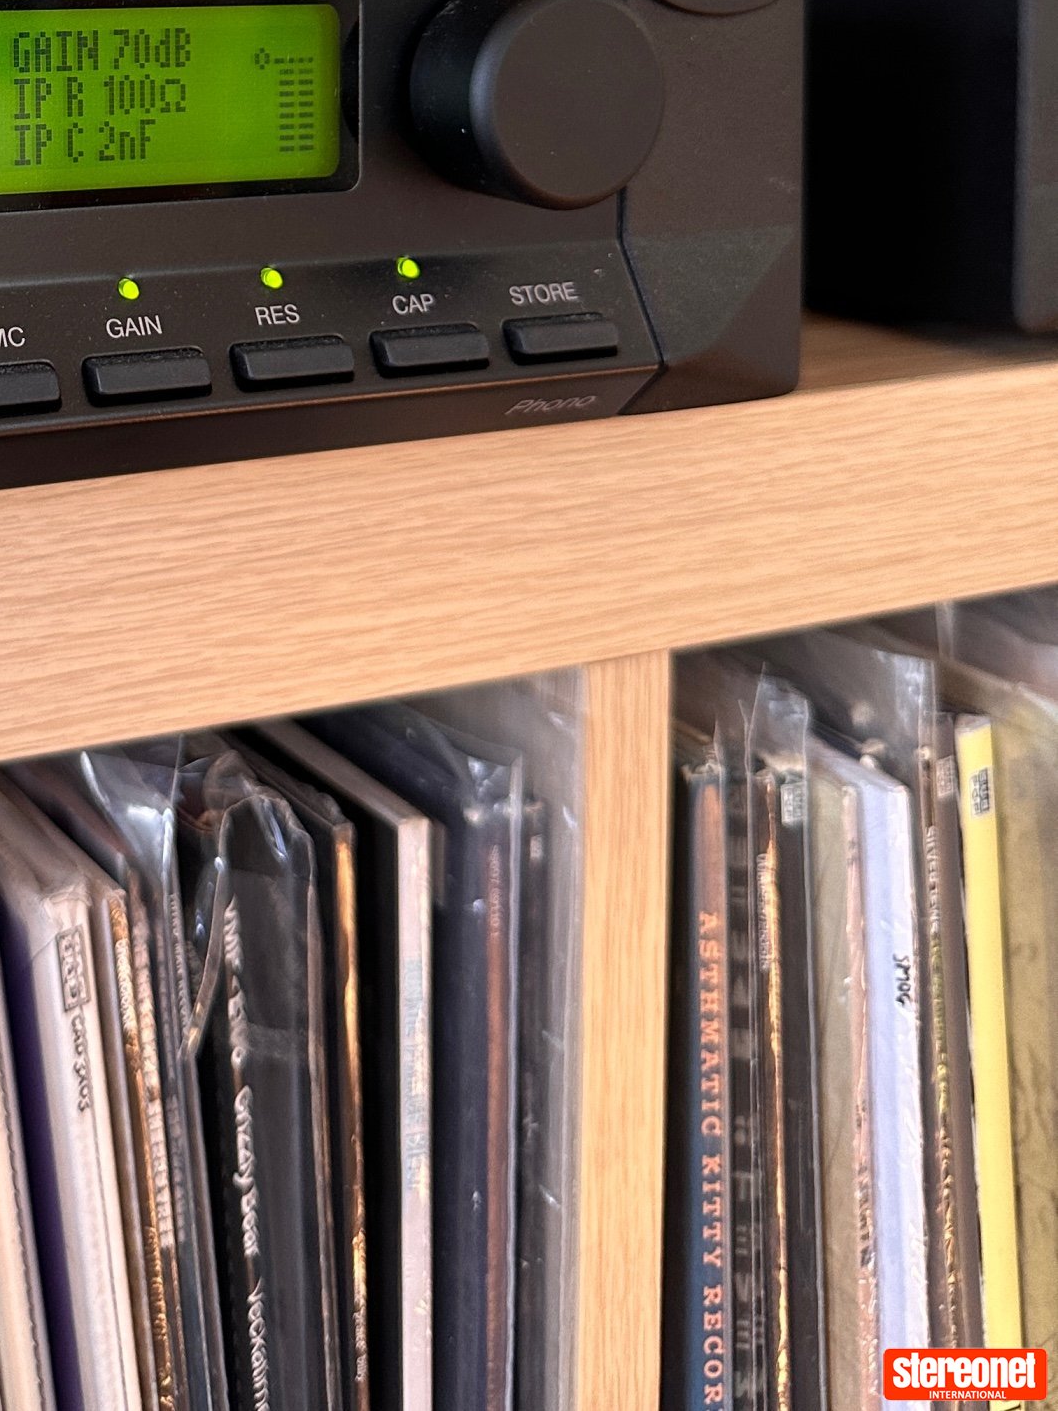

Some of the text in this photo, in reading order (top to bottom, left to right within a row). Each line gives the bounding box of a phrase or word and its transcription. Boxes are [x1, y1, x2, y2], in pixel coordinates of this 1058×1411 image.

[13, 27, 192, 75] GAIN 70dB
[13, 77, 53, 120] IP
[67, 75, 84, 118] R
[13, 119, 156, 167] IP C 2nF
[392, 292, 435, 316] CAP
[508, 280, 580, 306] STORE
[105, 314, 164, 340] GAIN
[255, 302, 301, 327] RES
[504, 393, 597, 416] Phono
[699, 910, 725, 1411] ASTHMATIC KITTY RECOR
